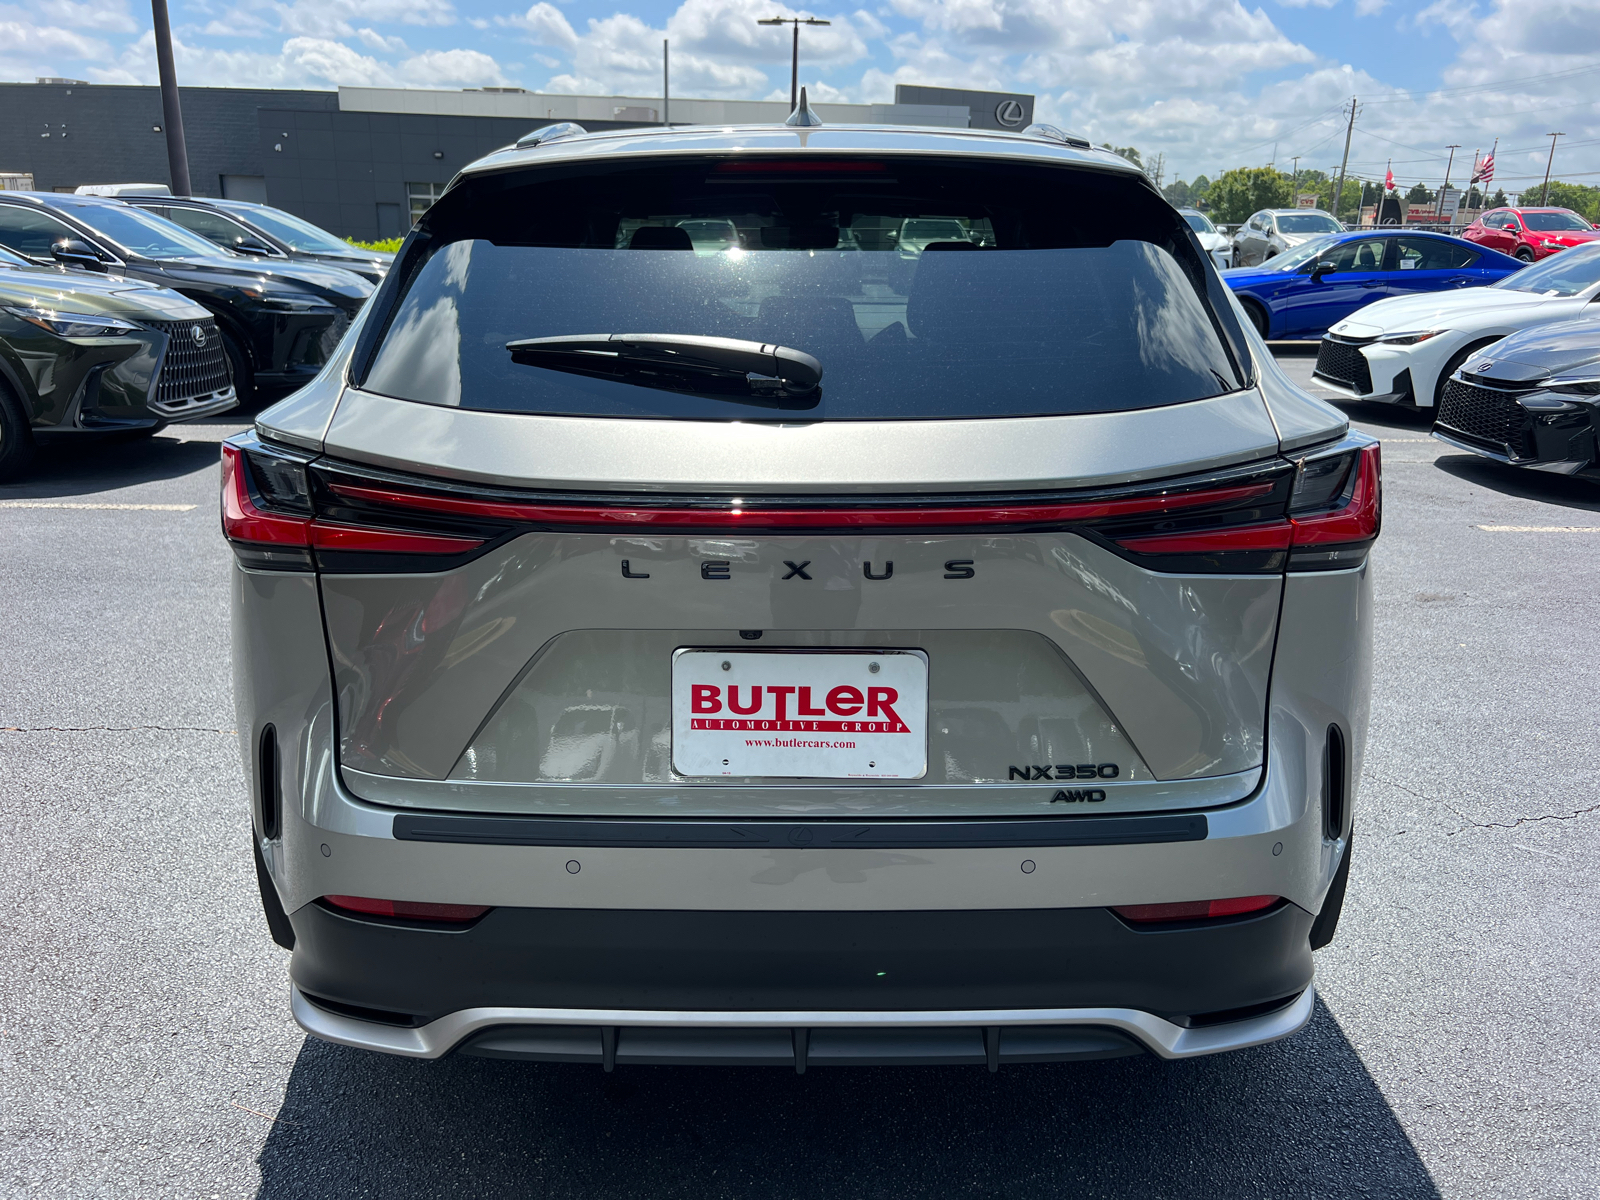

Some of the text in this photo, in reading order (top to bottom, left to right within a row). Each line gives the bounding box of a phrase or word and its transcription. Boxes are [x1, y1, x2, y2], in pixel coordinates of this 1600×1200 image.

[621, 559, 975, 580] LEXUS
[692, 720, 903, 732] AUTOMOTIVE GROUP
[745, 738, 856, 749] www.butlercars.com
[1008, 763, 1119, 780] NX350
[1050, 789, 1106, 803] AWD
